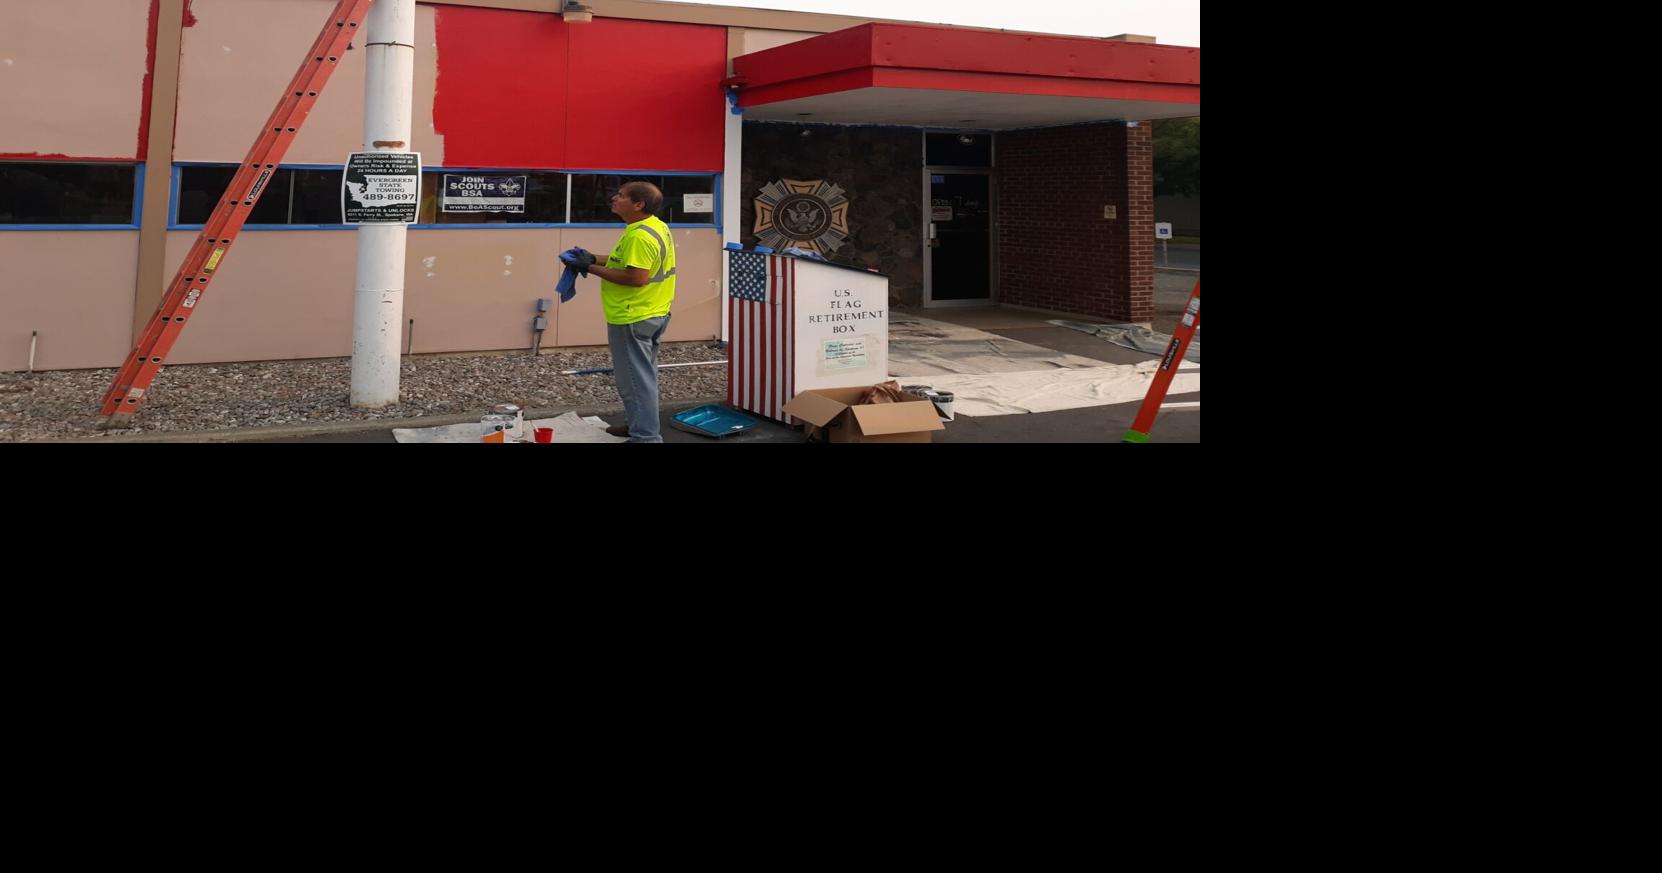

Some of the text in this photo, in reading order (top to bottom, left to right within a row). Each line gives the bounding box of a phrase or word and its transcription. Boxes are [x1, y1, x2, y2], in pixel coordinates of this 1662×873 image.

[363, 193, 415, 201] 489-8697
[834, 289, 853, 297] U.S.
[830, 300, 862, 309] FLAG
[809, 310, 884, 324] RETIREMENT
[833, 324, 856, 334] BOX
